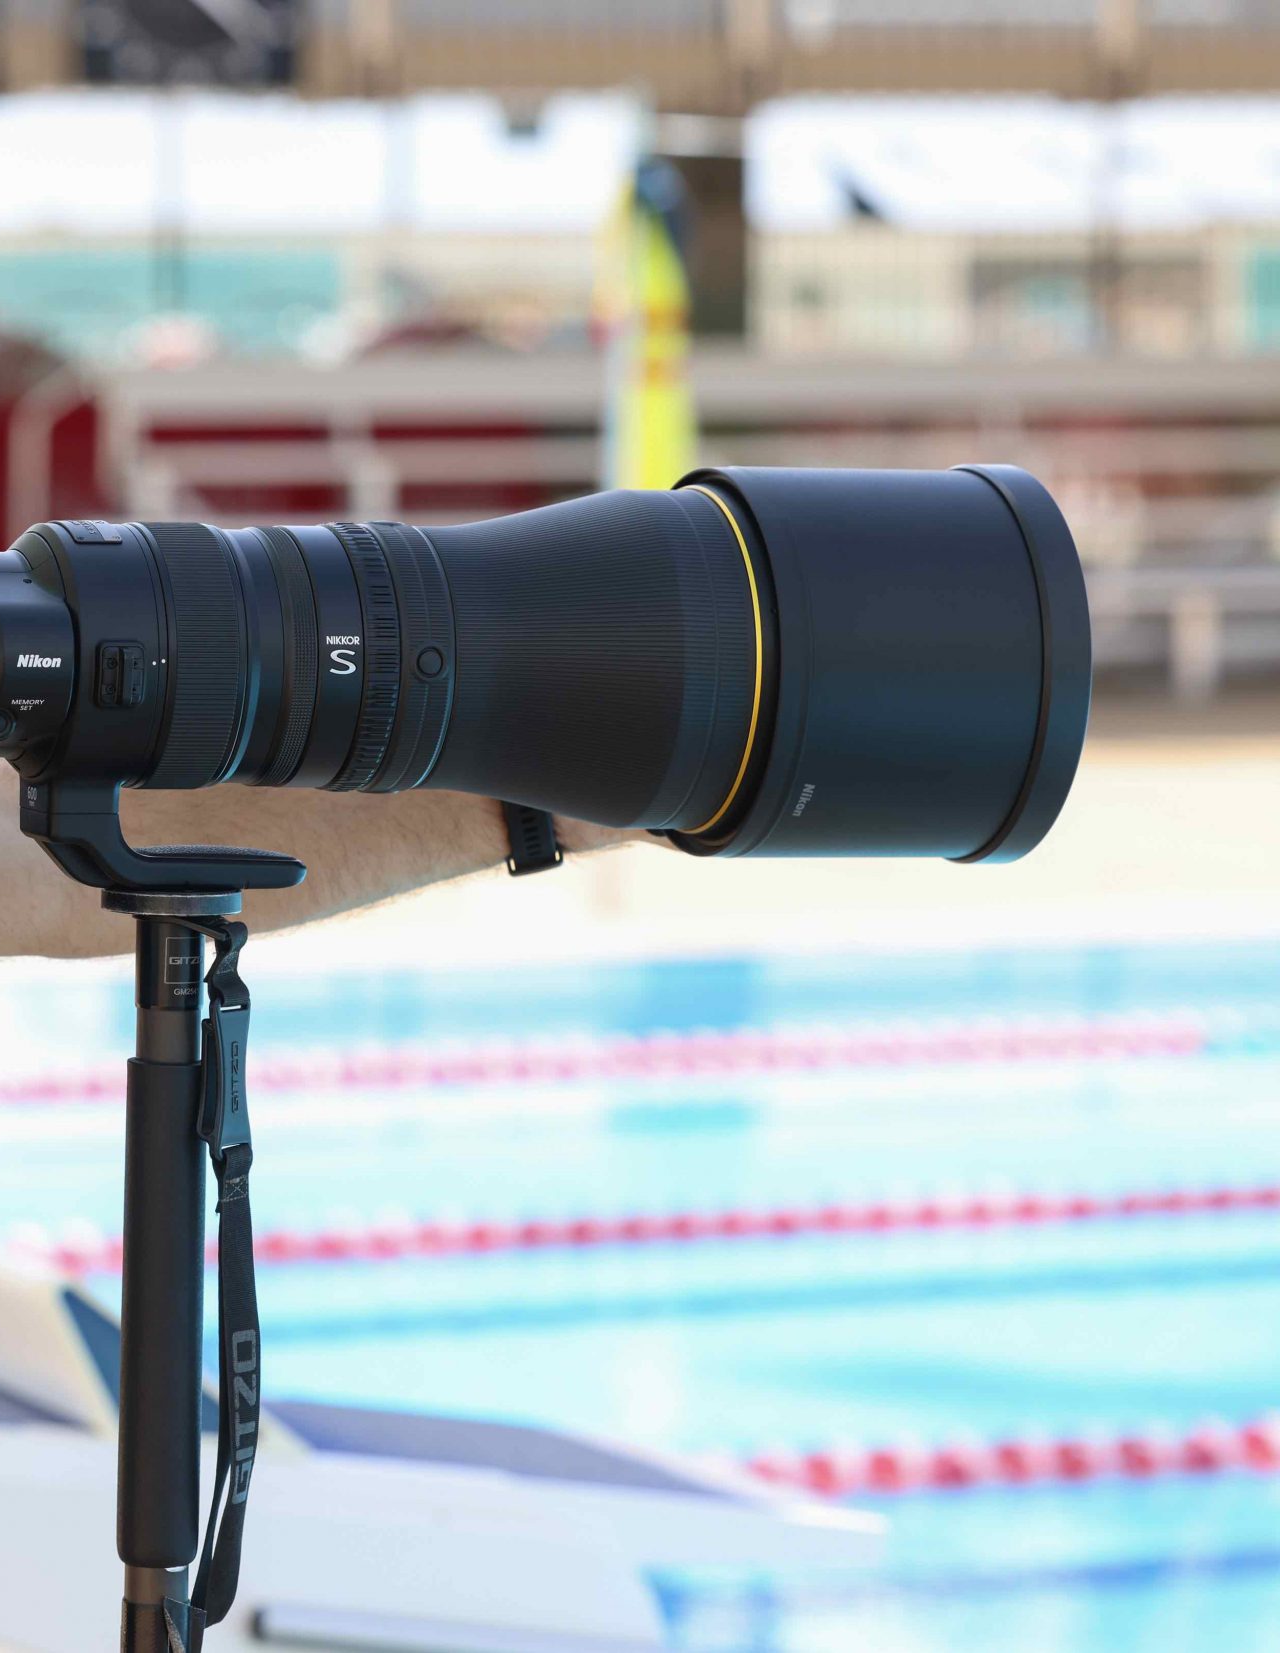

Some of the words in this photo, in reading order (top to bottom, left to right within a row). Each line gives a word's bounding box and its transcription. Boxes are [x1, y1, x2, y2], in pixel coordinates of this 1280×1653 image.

[325, 635, 360, 645] NIKKOR
[16, 654, 62, 668] Nikon
[329, 649, 357, 675] S
[792, 783, 816, 817] Nikon
[231, 1040, 239, 1114] GITZO
[232, 1329, 257, 1505] GITZO
